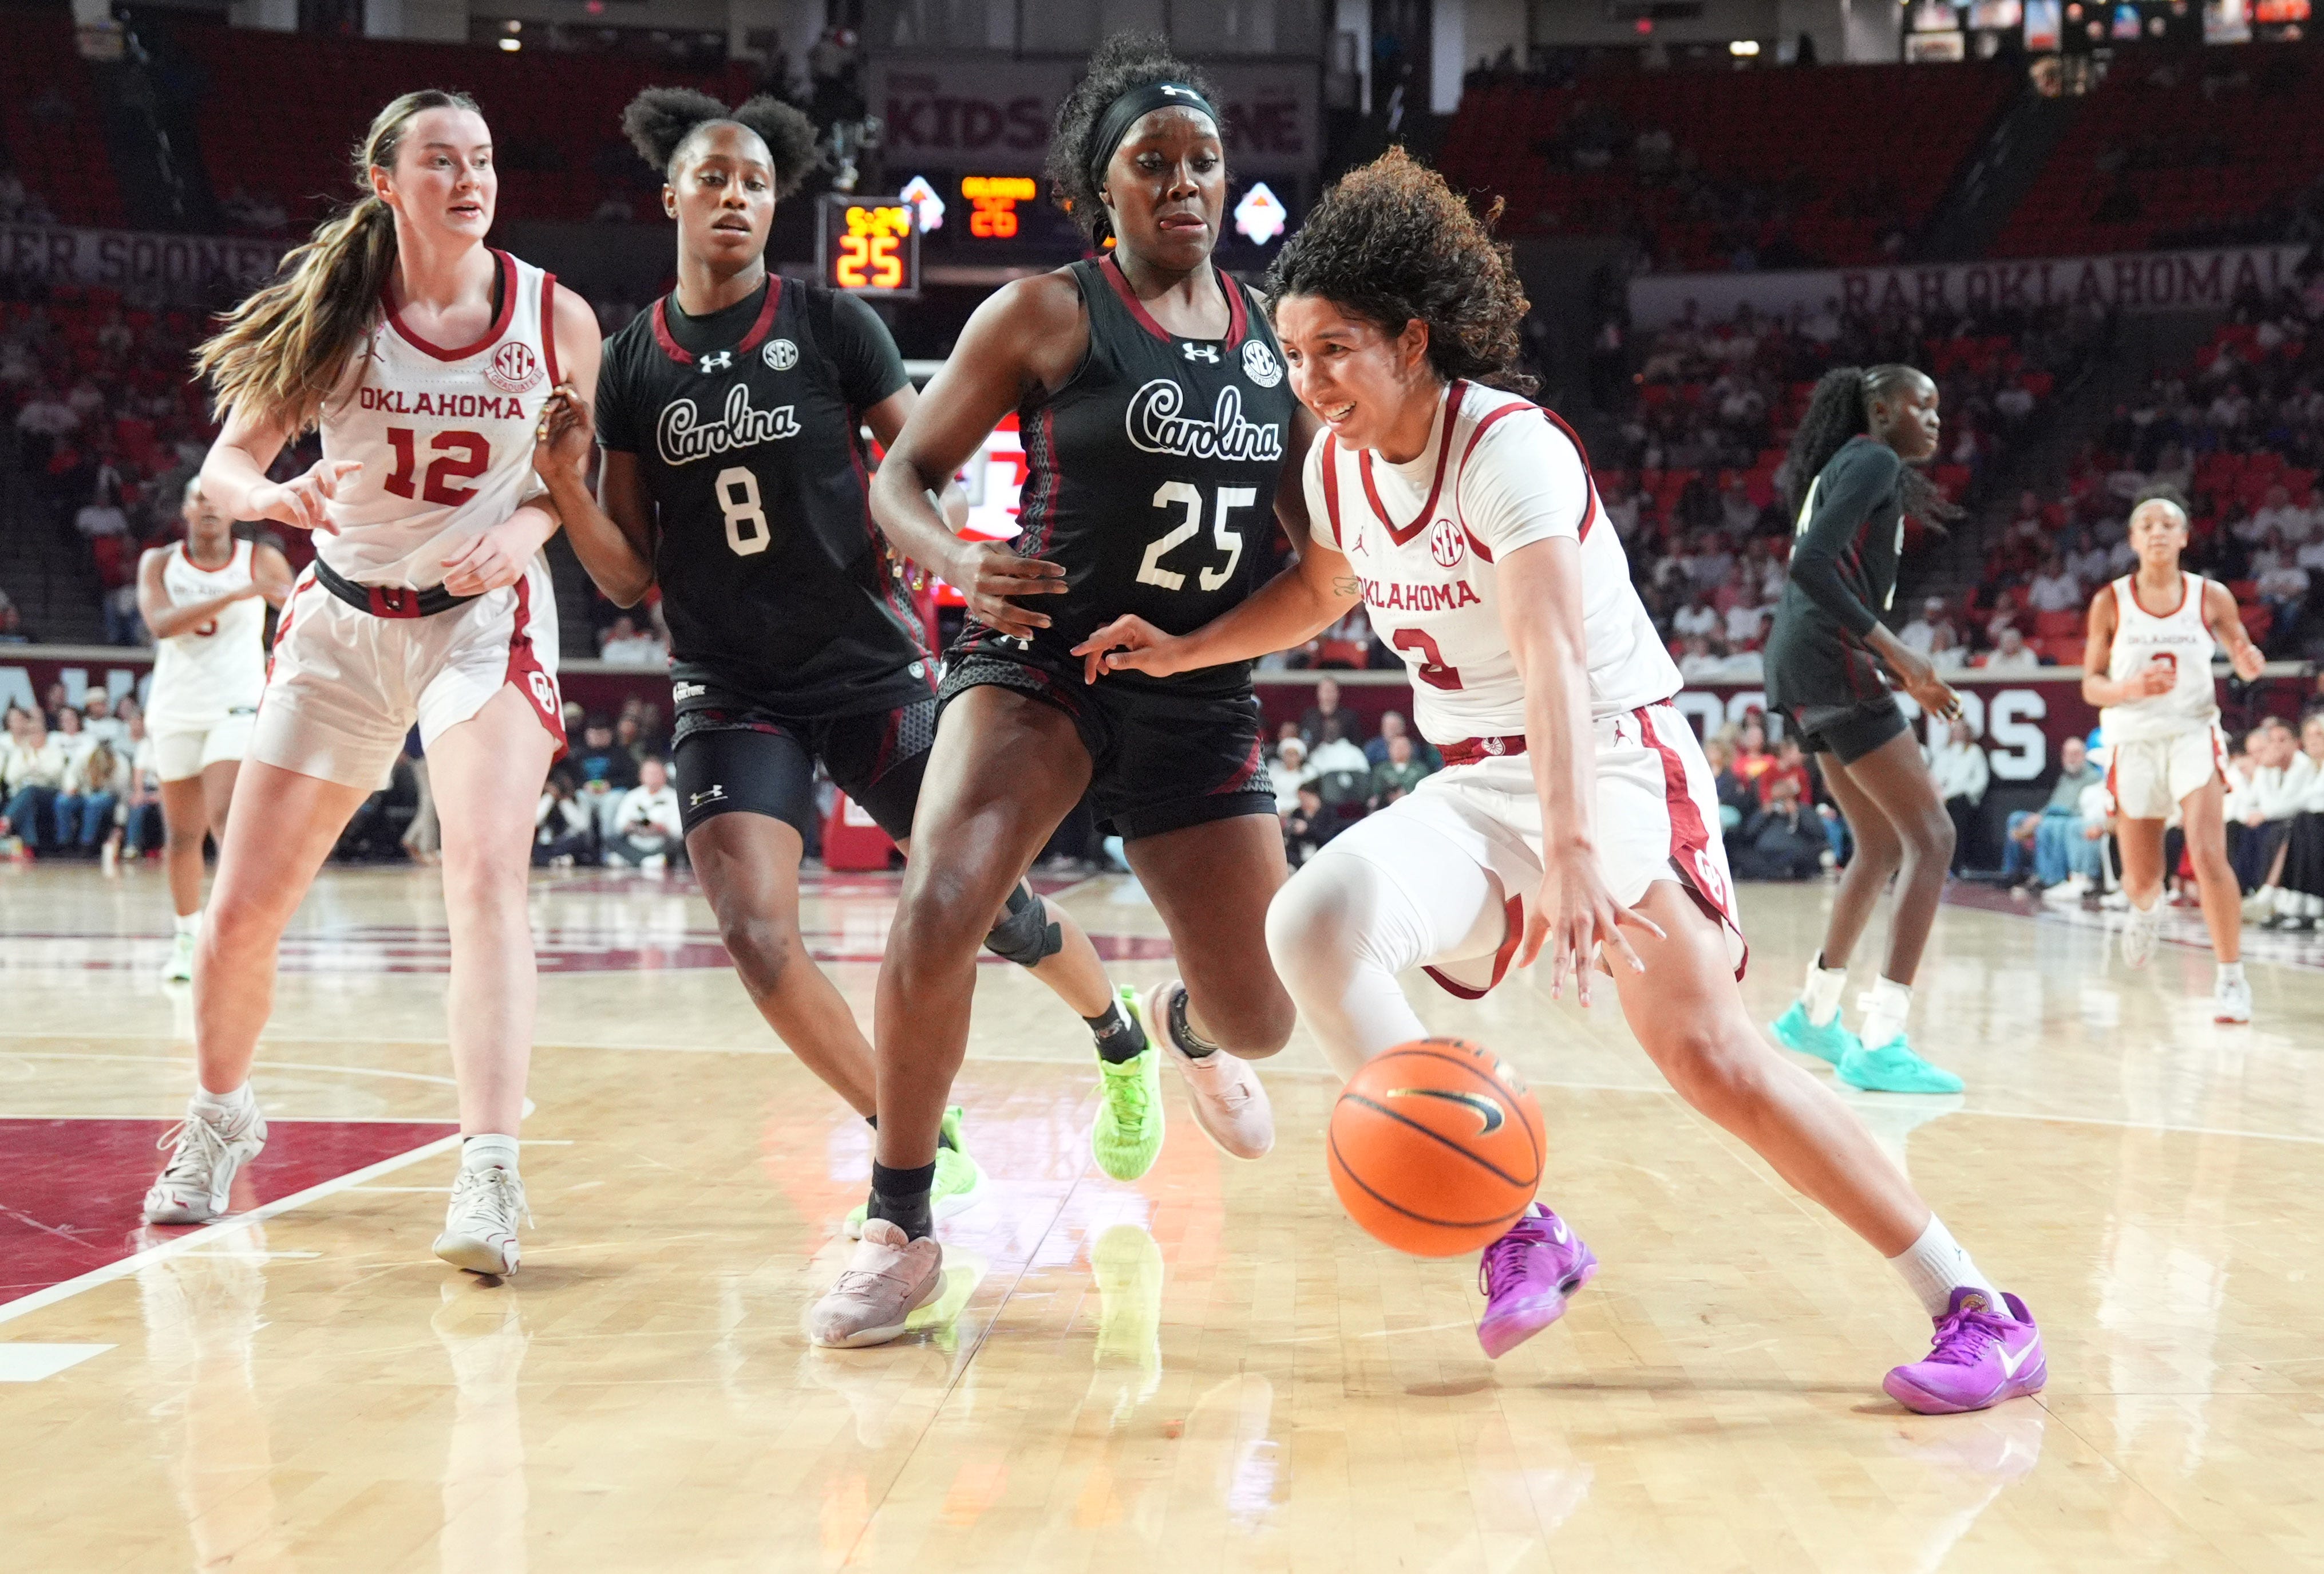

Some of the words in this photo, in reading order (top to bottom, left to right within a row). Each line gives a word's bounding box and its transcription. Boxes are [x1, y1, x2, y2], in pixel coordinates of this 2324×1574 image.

[887, 97, 1052, 148] KIDS
[837, 235, 902, 287] 25
[1842, 268, 1945, 313] RAH
[496, 343, 534, 380] SEC
[766, 341, 796, 368] SEC
[1245, 342, 1275, 376] SEC
[1248, 370, 1280, 386] GRADUATE
[360, 386, 525, 420] OKLAHOMA
[657, 383, 801, 466] Carolina
[1126, 378, 1282, 461] Carolina
[384, 427, 490, 507] 12
[715, 466, 771, 557] 8
[1135, 480, 1257, 591] 25
[1432, 520, 1464, 566] SEC
[1356, 575, 1481, 611] OKLAHOMA
[1392, 629, 1464, 690] 2
[528, 670, 555, 715] OU
[1694, 849, 1724, 906] OU
